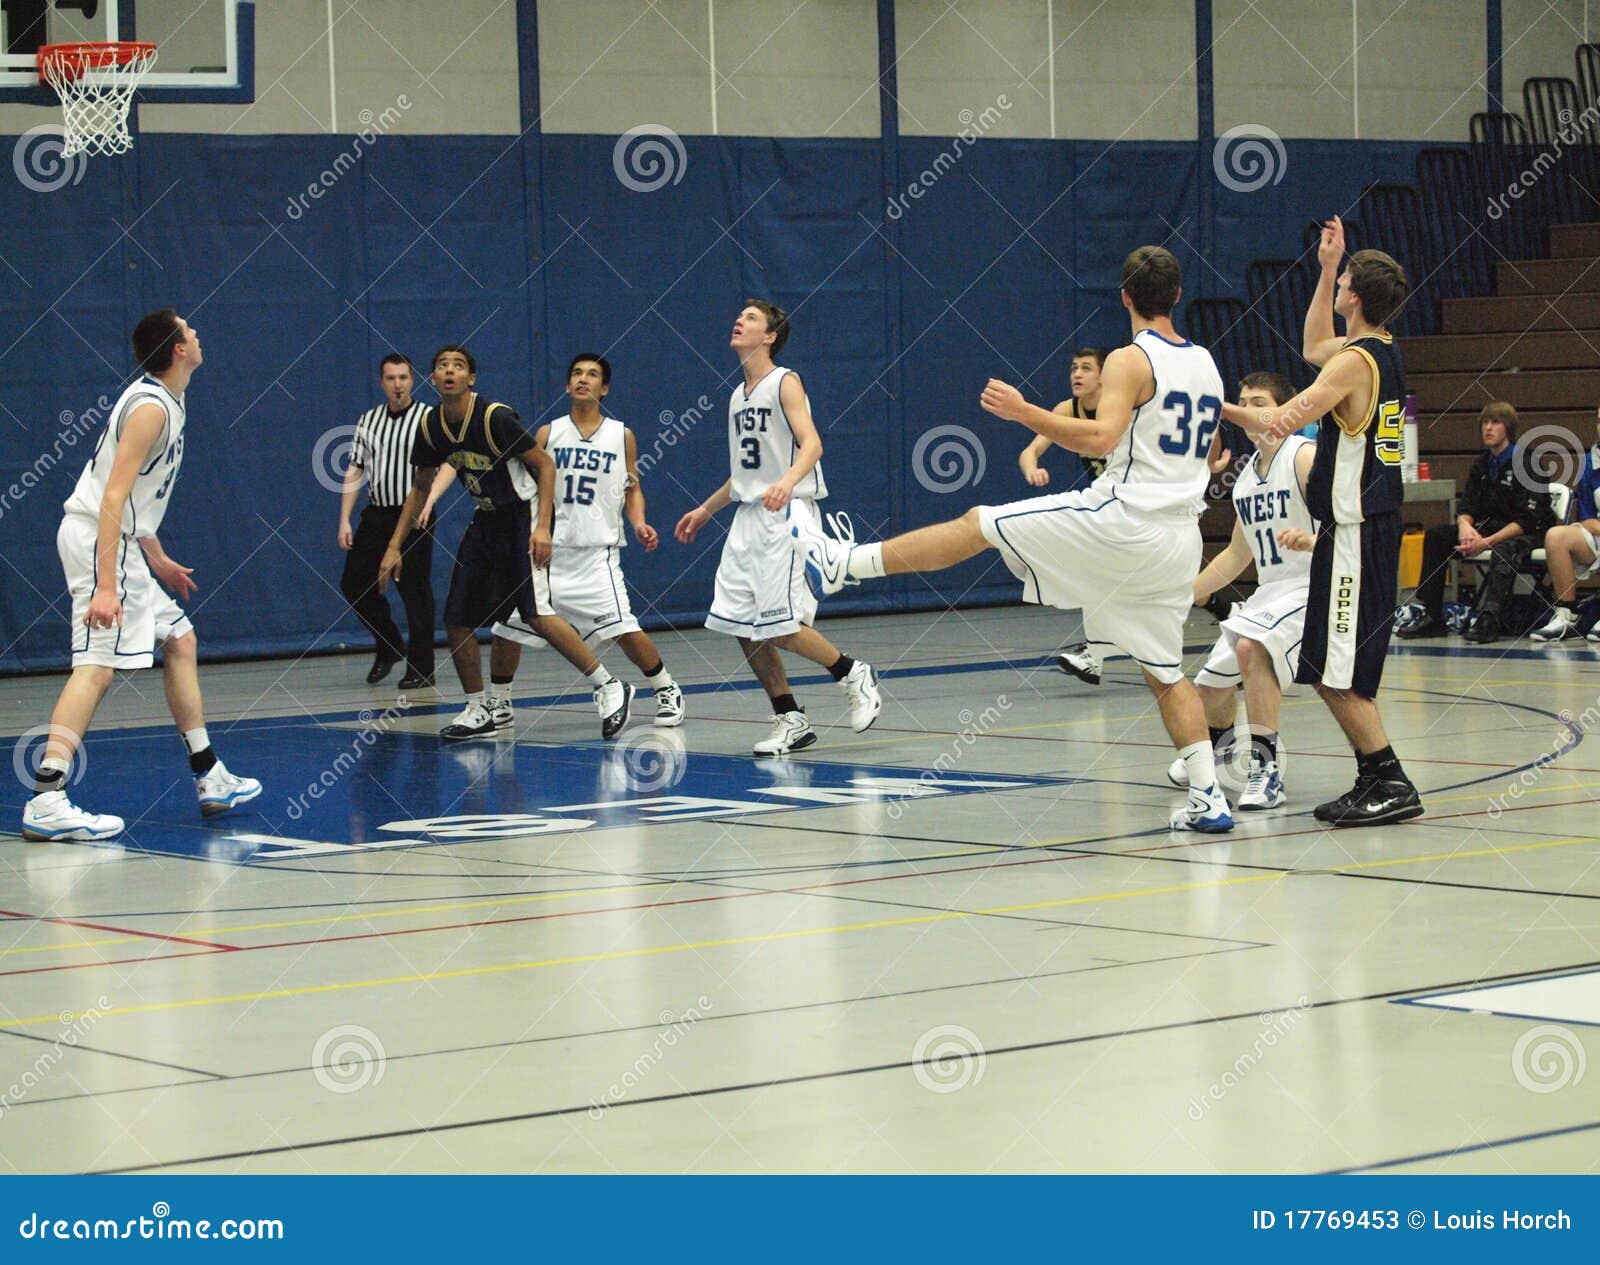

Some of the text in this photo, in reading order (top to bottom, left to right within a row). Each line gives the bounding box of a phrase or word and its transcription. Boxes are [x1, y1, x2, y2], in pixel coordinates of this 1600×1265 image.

[1158, 390, 1223, 459] 32
[553, 447, 617, 474] WEST
[741, 437, 761, 469] 3
[563, 475, 597, 506] 15
[1236, 489, 1291, 527] WEST
[1255, 527, 1283, 567] 11
[1336, 576, 1353, 633] POPES
